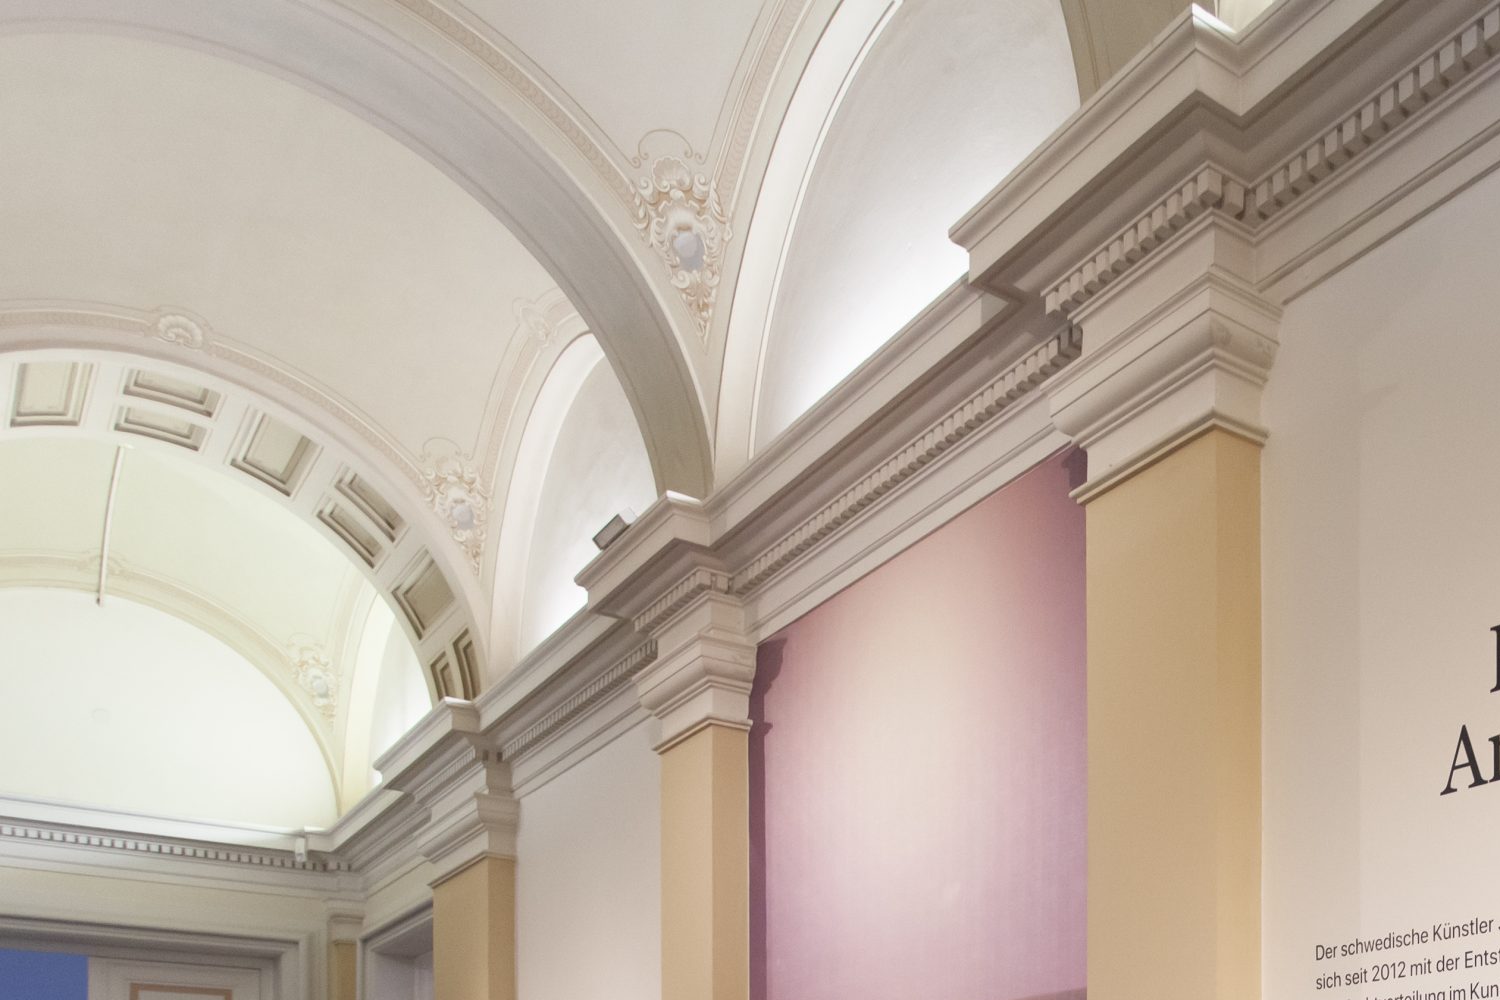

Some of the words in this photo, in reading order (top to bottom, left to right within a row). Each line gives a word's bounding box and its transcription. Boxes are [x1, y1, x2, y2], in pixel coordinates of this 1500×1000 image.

[1315, 943, 1339, 962] Der
[1340, 927, 1430, 958] schwedische
[1432, 916, 1495, 943] Künstler
